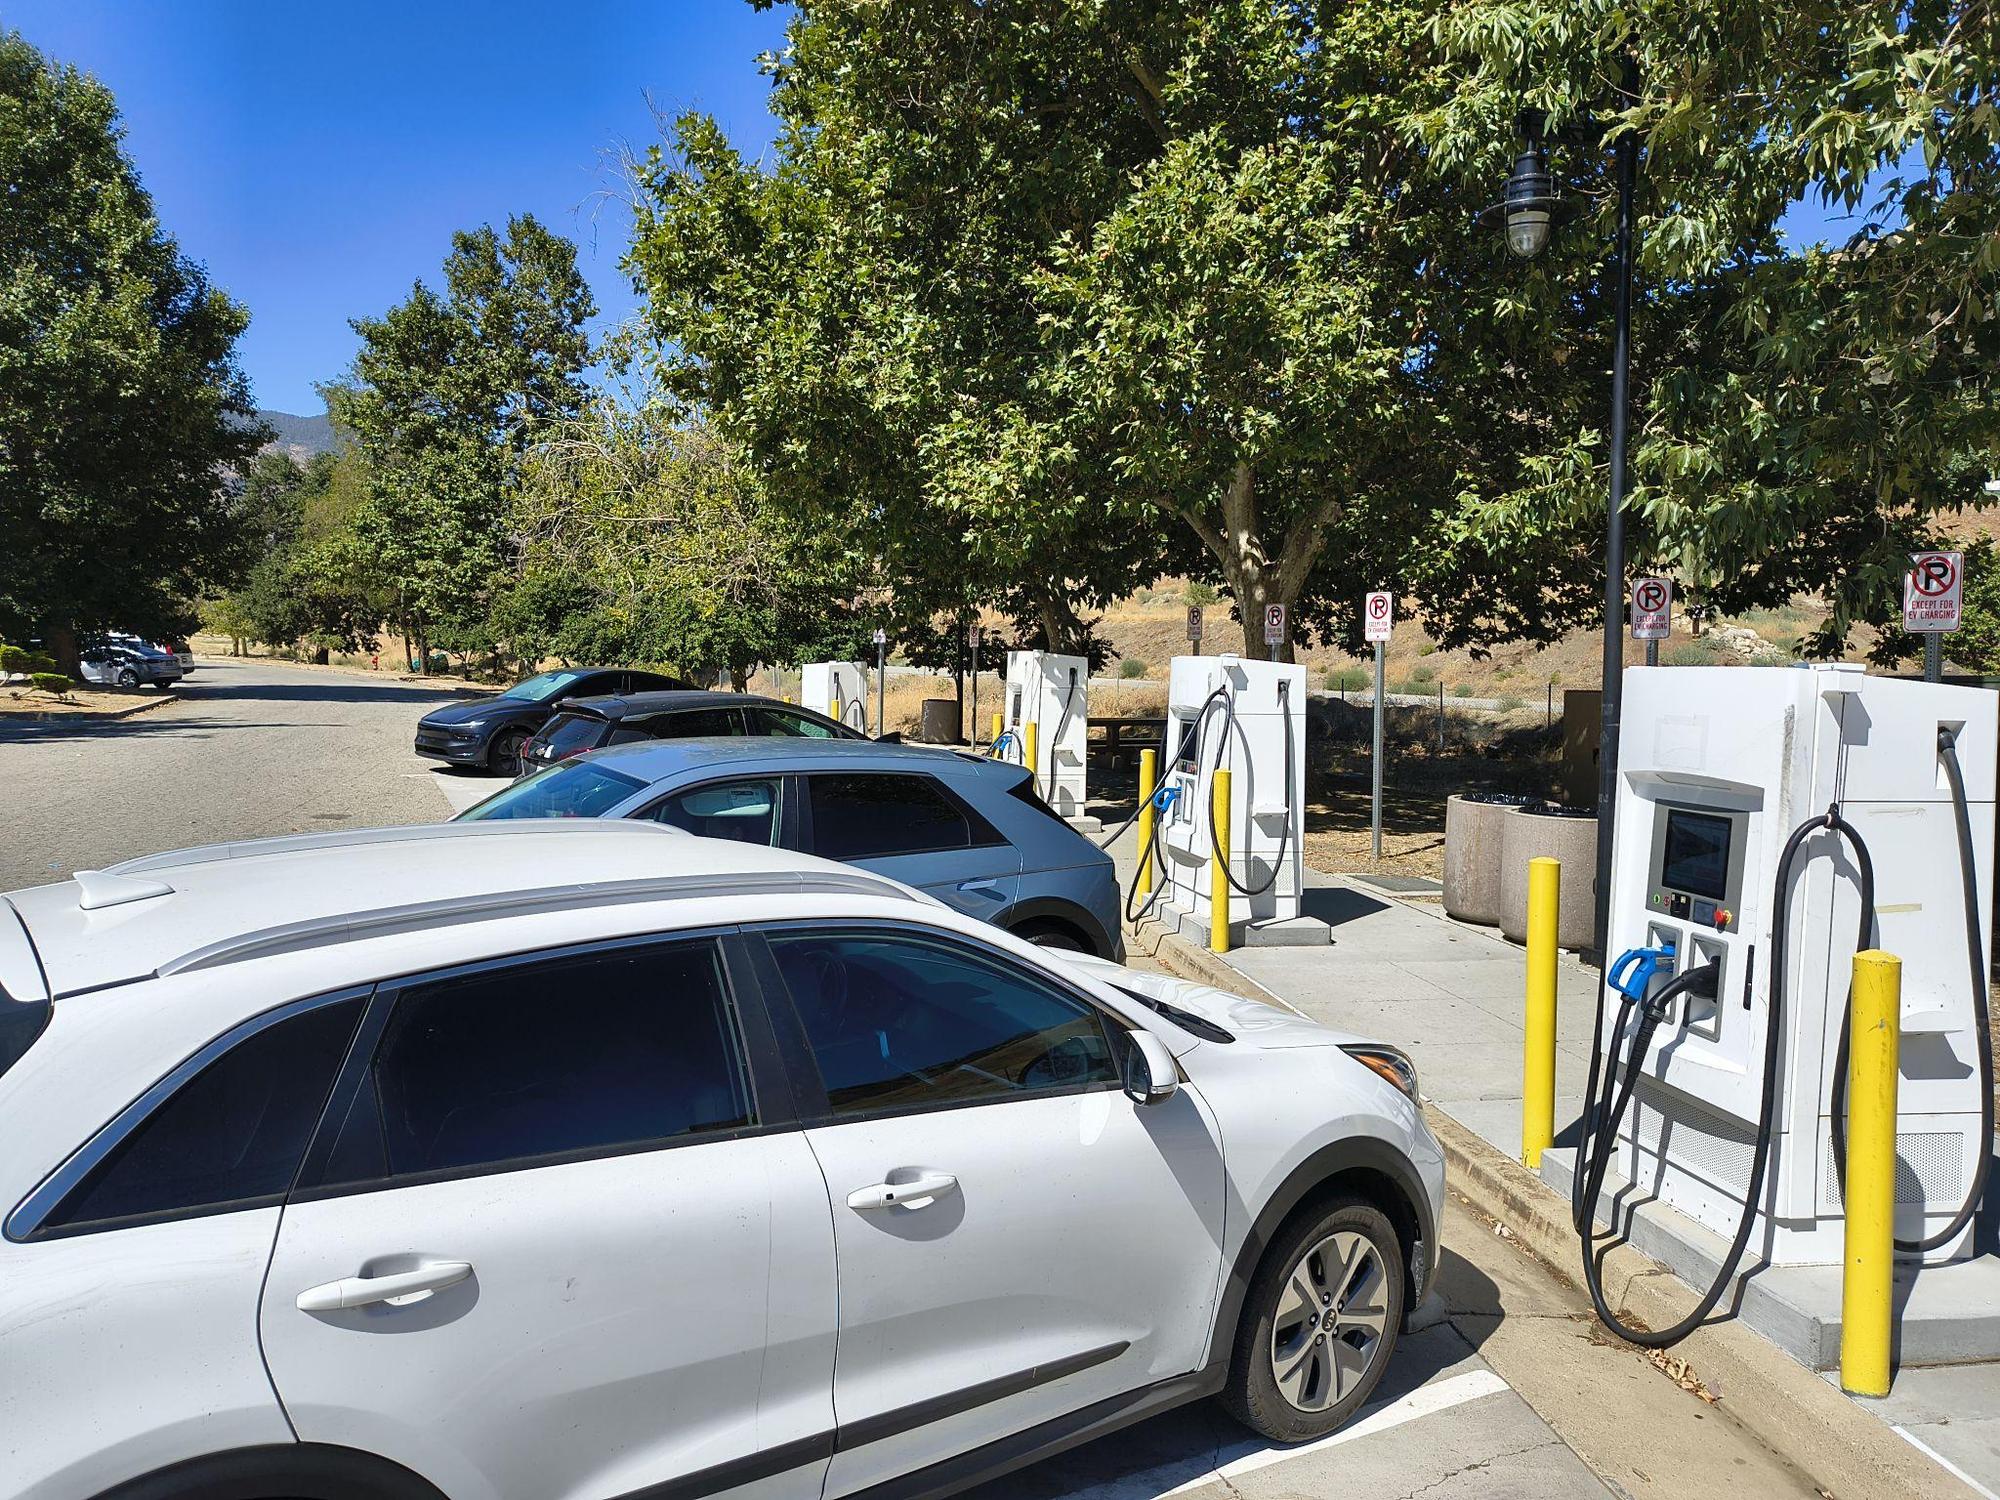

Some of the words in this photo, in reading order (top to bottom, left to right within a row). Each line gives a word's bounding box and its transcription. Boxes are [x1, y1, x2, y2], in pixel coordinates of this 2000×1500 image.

[1912, 600, 1937, 610] EXCEPT
[1939, 599, 1954, 609] FOR
[1908, 610, 1918, 620] EV
[1920, 610, 1956, 620] CHARGING
